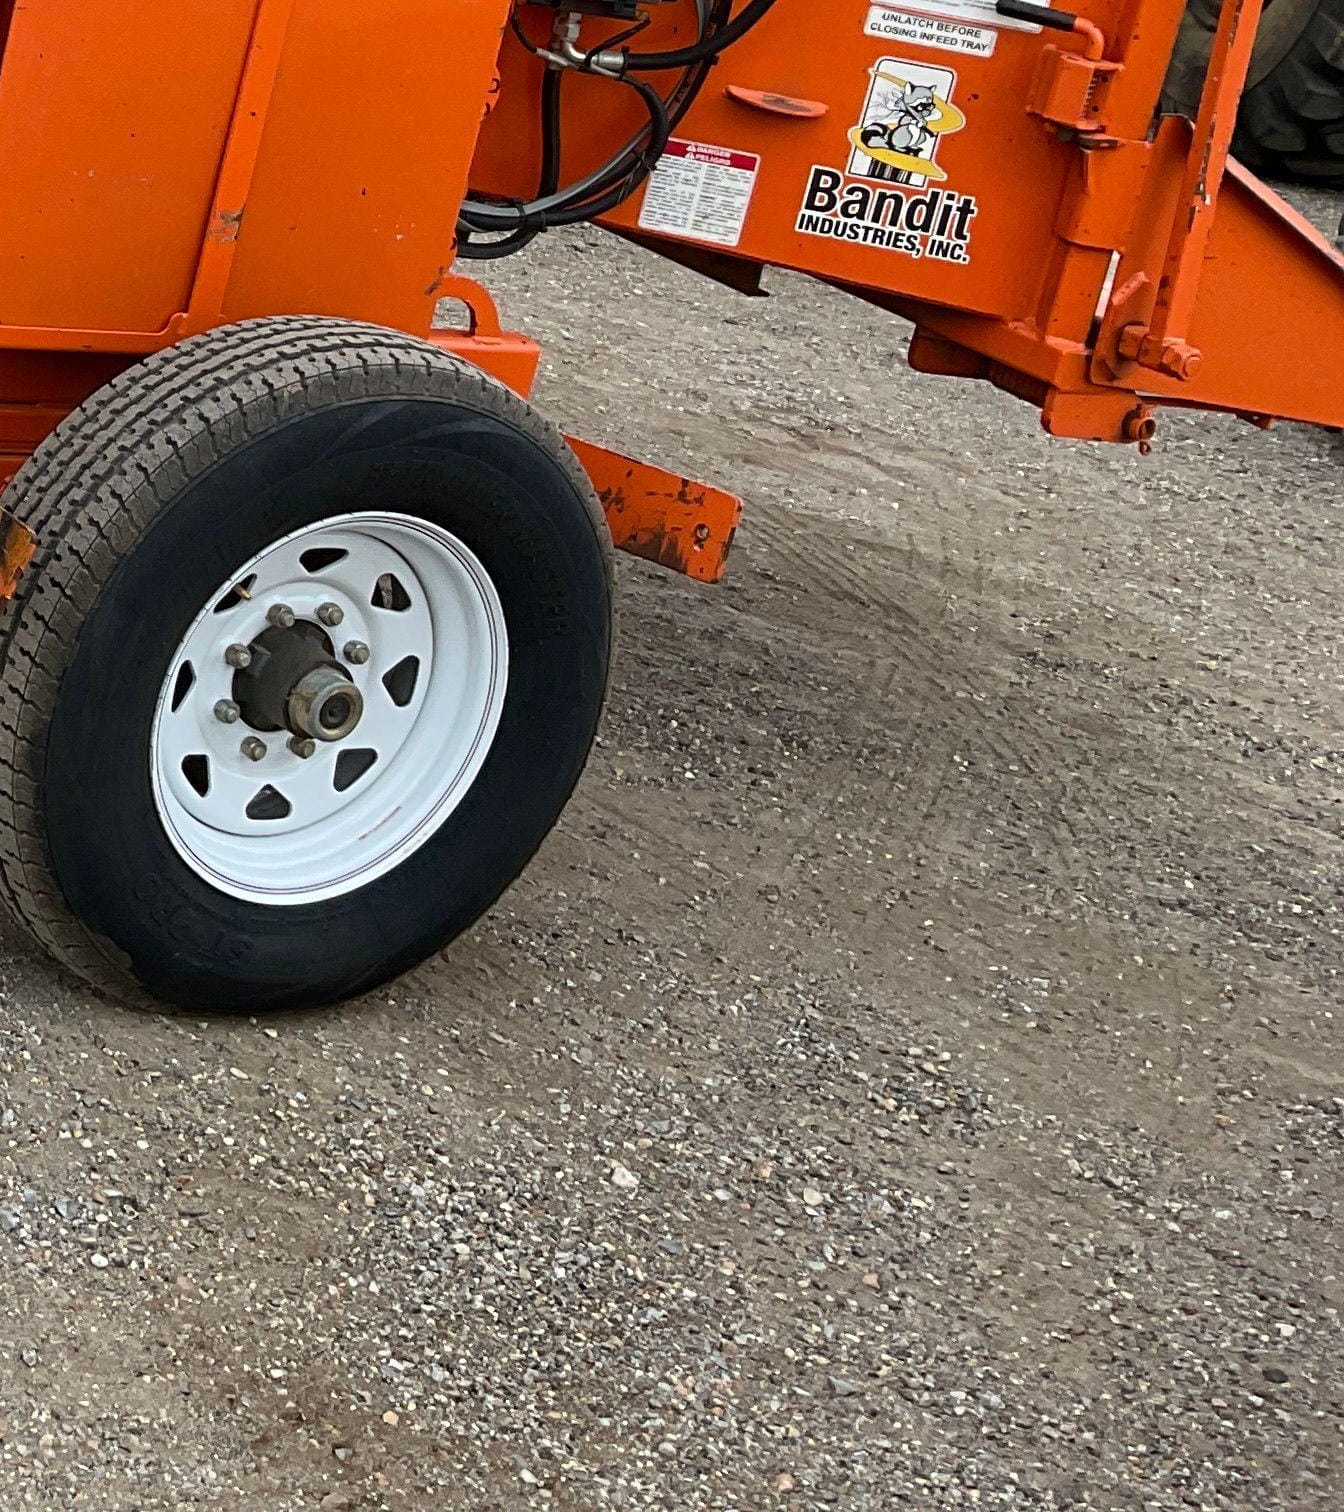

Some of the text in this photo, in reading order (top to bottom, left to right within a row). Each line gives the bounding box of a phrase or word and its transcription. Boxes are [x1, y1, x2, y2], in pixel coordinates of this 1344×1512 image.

[870, 22, 989, 52] CLOSING INFEED TRAY
[882, 12, 982, 39] UNLATCH BEFORE
[804, 168, 975, 240] Bandit
[798, 213, 968, 262] INDUSTRIES, INC.
